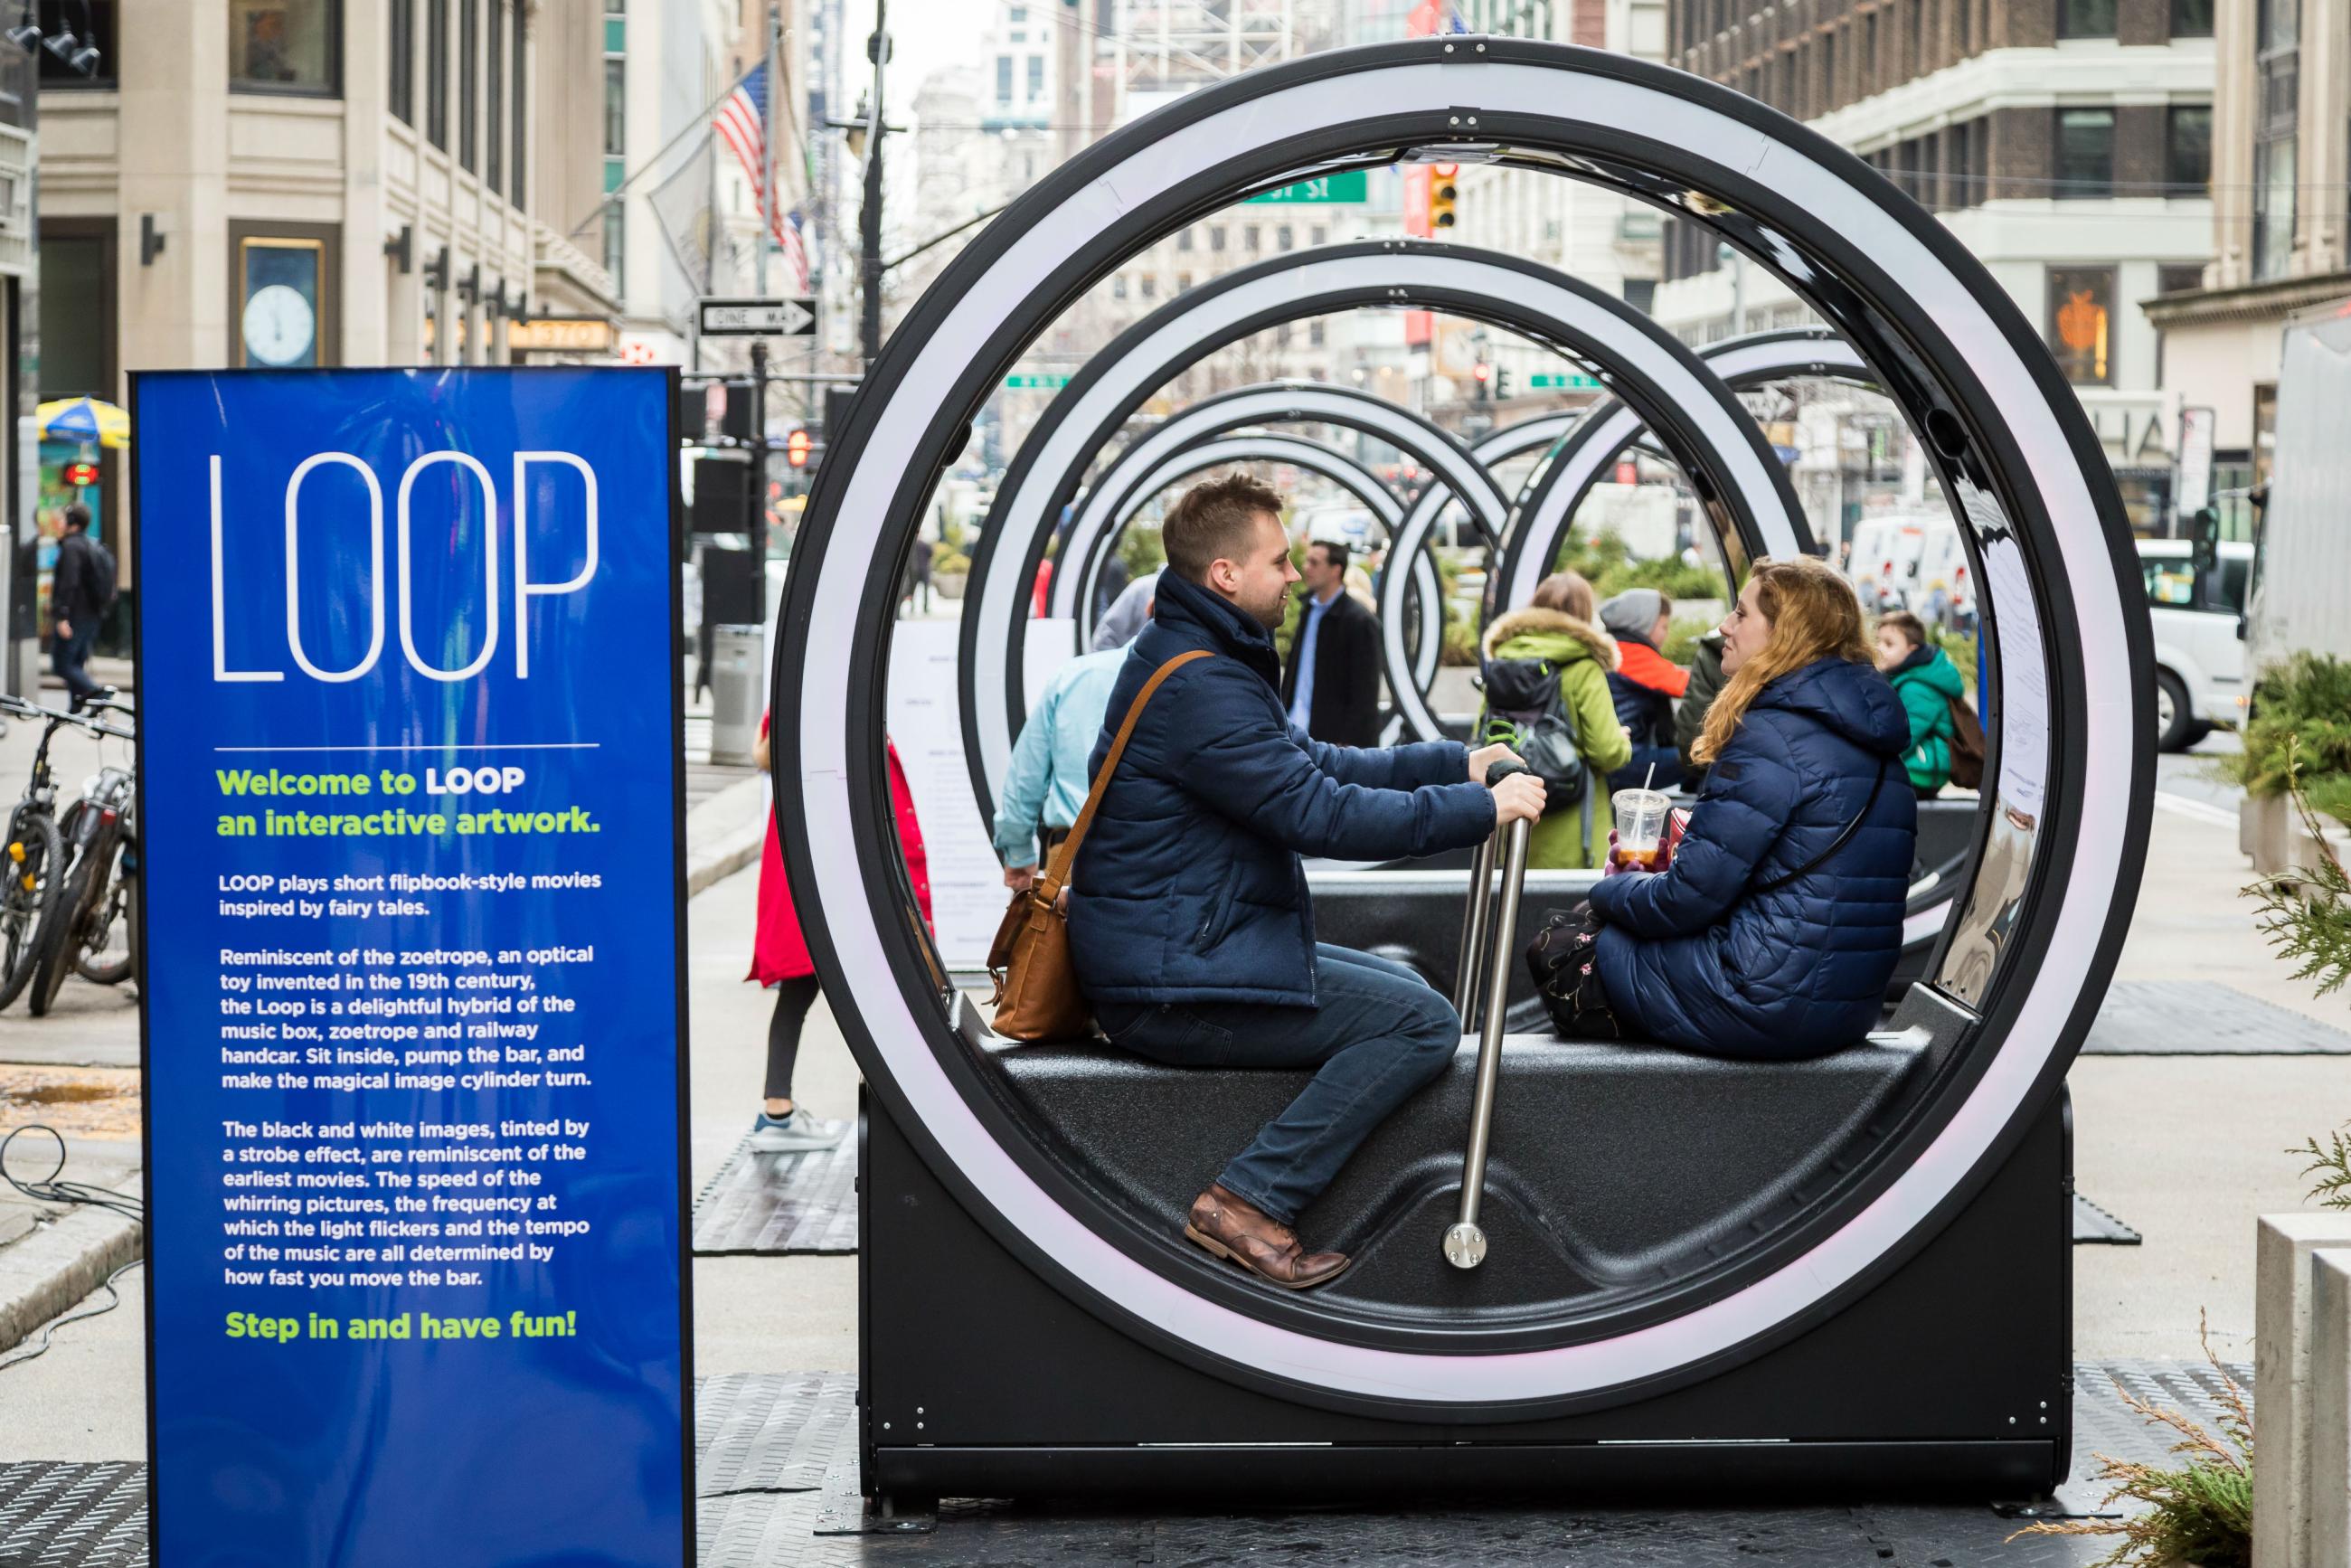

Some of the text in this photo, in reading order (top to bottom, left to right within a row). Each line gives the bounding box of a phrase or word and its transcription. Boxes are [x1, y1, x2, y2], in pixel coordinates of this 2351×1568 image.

[713, 308, 798, 325] ONE WAY
[209, 450, 599, 683] LOOP
[216, 766, 525, 796] Welcome to LOOP
[217, 806, 600, 836] an interactive artwork.
[219, 871, 602, 894] LOOP plays short flipbook-style movies
[219, 898, 430, 919] inspired by fairy tales.
[220, 945, 594, 968] Reminiscent of the zoetrope, an optical
[220, 972, 536, 993] toy invented in the 19th century,
[220, 995, 576, 1018] the Loop is a delightful hybrid of the
[221, 1021, 539, 1043] music box, zoetrope and railway
[222, 1044, 585, 1067] handcar. Sit inside, pump the bar, and
[222, 1070, 591, 1092] make the magical image cylinder turn.
[222, 1119, 590, 1141] The black and white images, tinted by
[222, 1143, 587, 1166] a strobe effect, are reminiscent of the
[222, 1168, 542, 1191] earliest movies. The speed of the
[223, 1194, 557, 1215] whirring pictures, the frequency at
[223, 1218, 590, 1240] which the light flickers and the tempo
[224, 1242, 554, 1262] of the music are all determined by
[224, 1268, 483, 1289] how fast you move the bar.
[226, 1310, 576, 1343] Step in and have fun!
